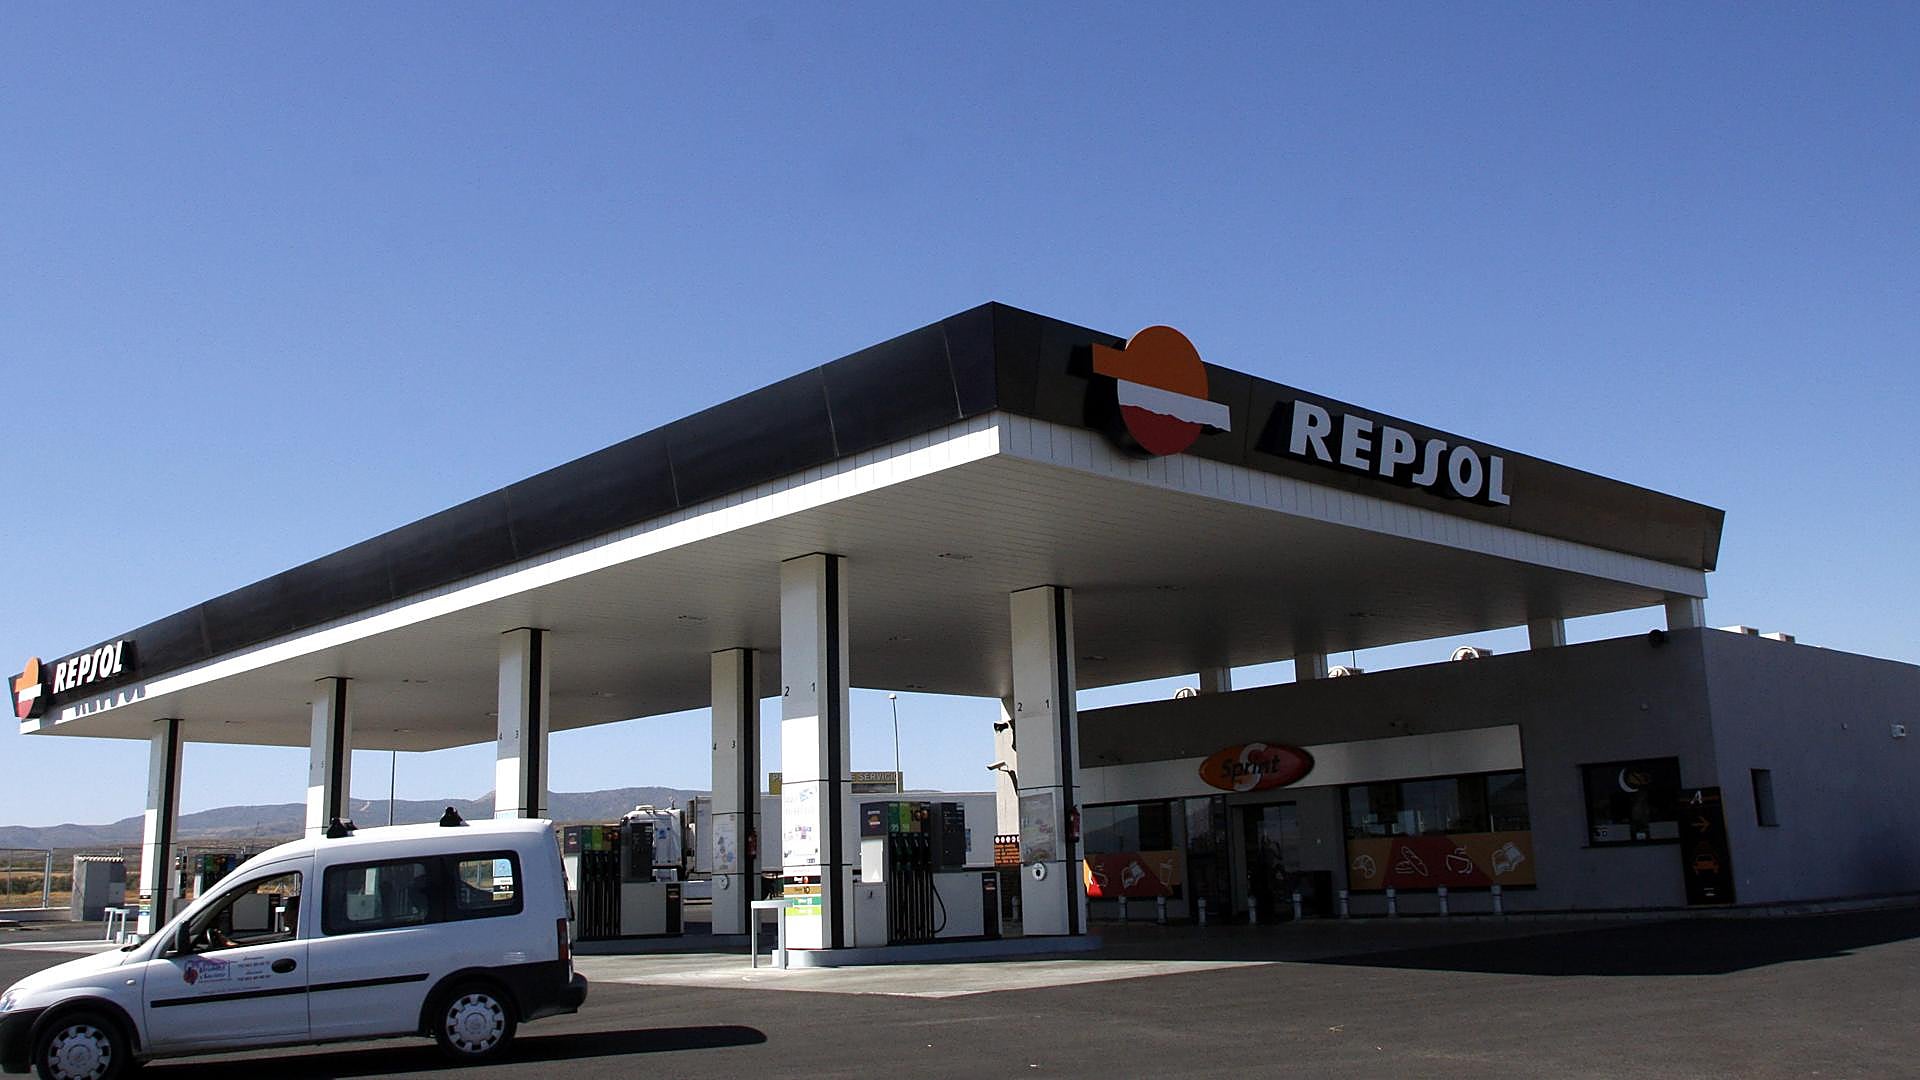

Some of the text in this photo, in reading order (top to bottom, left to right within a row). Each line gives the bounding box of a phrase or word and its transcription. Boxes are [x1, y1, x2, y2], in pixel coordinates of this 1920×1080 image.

[1289, 399, 1511, 506] REPSOL
[53, 639, 125, 694] REPSOL
[784, 686, 790, 697] 2
[859, 773, 898, 781] SERVICI
[1221, 755, 1281, 782] Sprint
